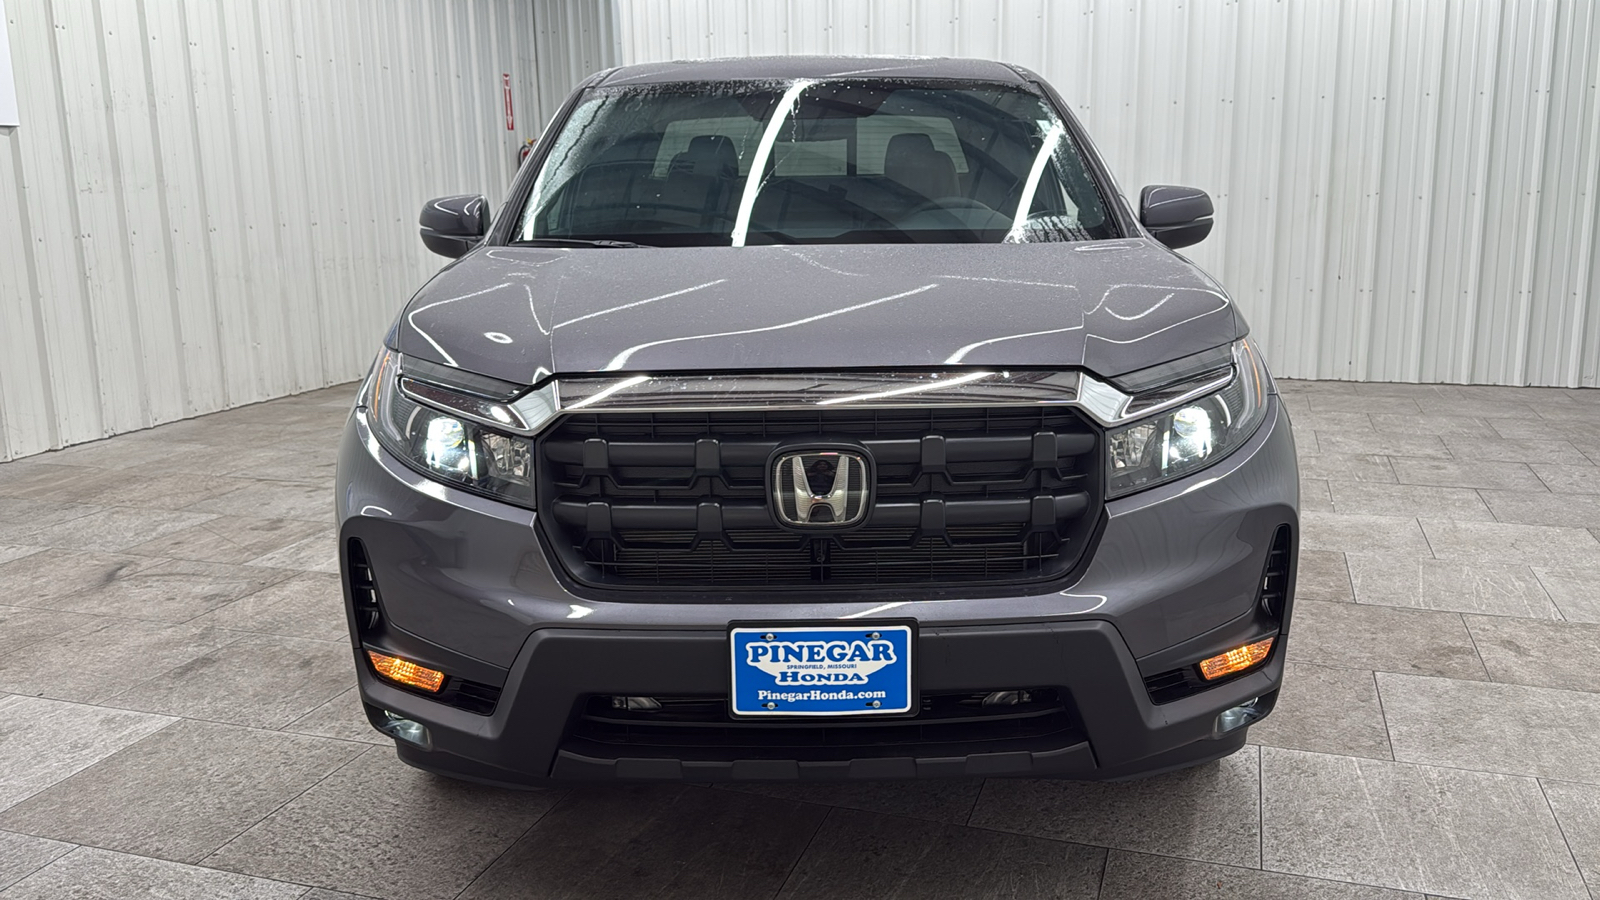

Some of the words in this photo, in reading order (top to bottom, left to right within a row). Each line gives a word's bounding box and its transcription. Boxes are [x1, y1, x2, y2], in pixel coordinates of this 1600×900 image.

[749, 643, 894, 663] PINEGAR
[779, 671, 865, 682] HONDA
[757, 690, 886, 702] PinegarHonda.com
